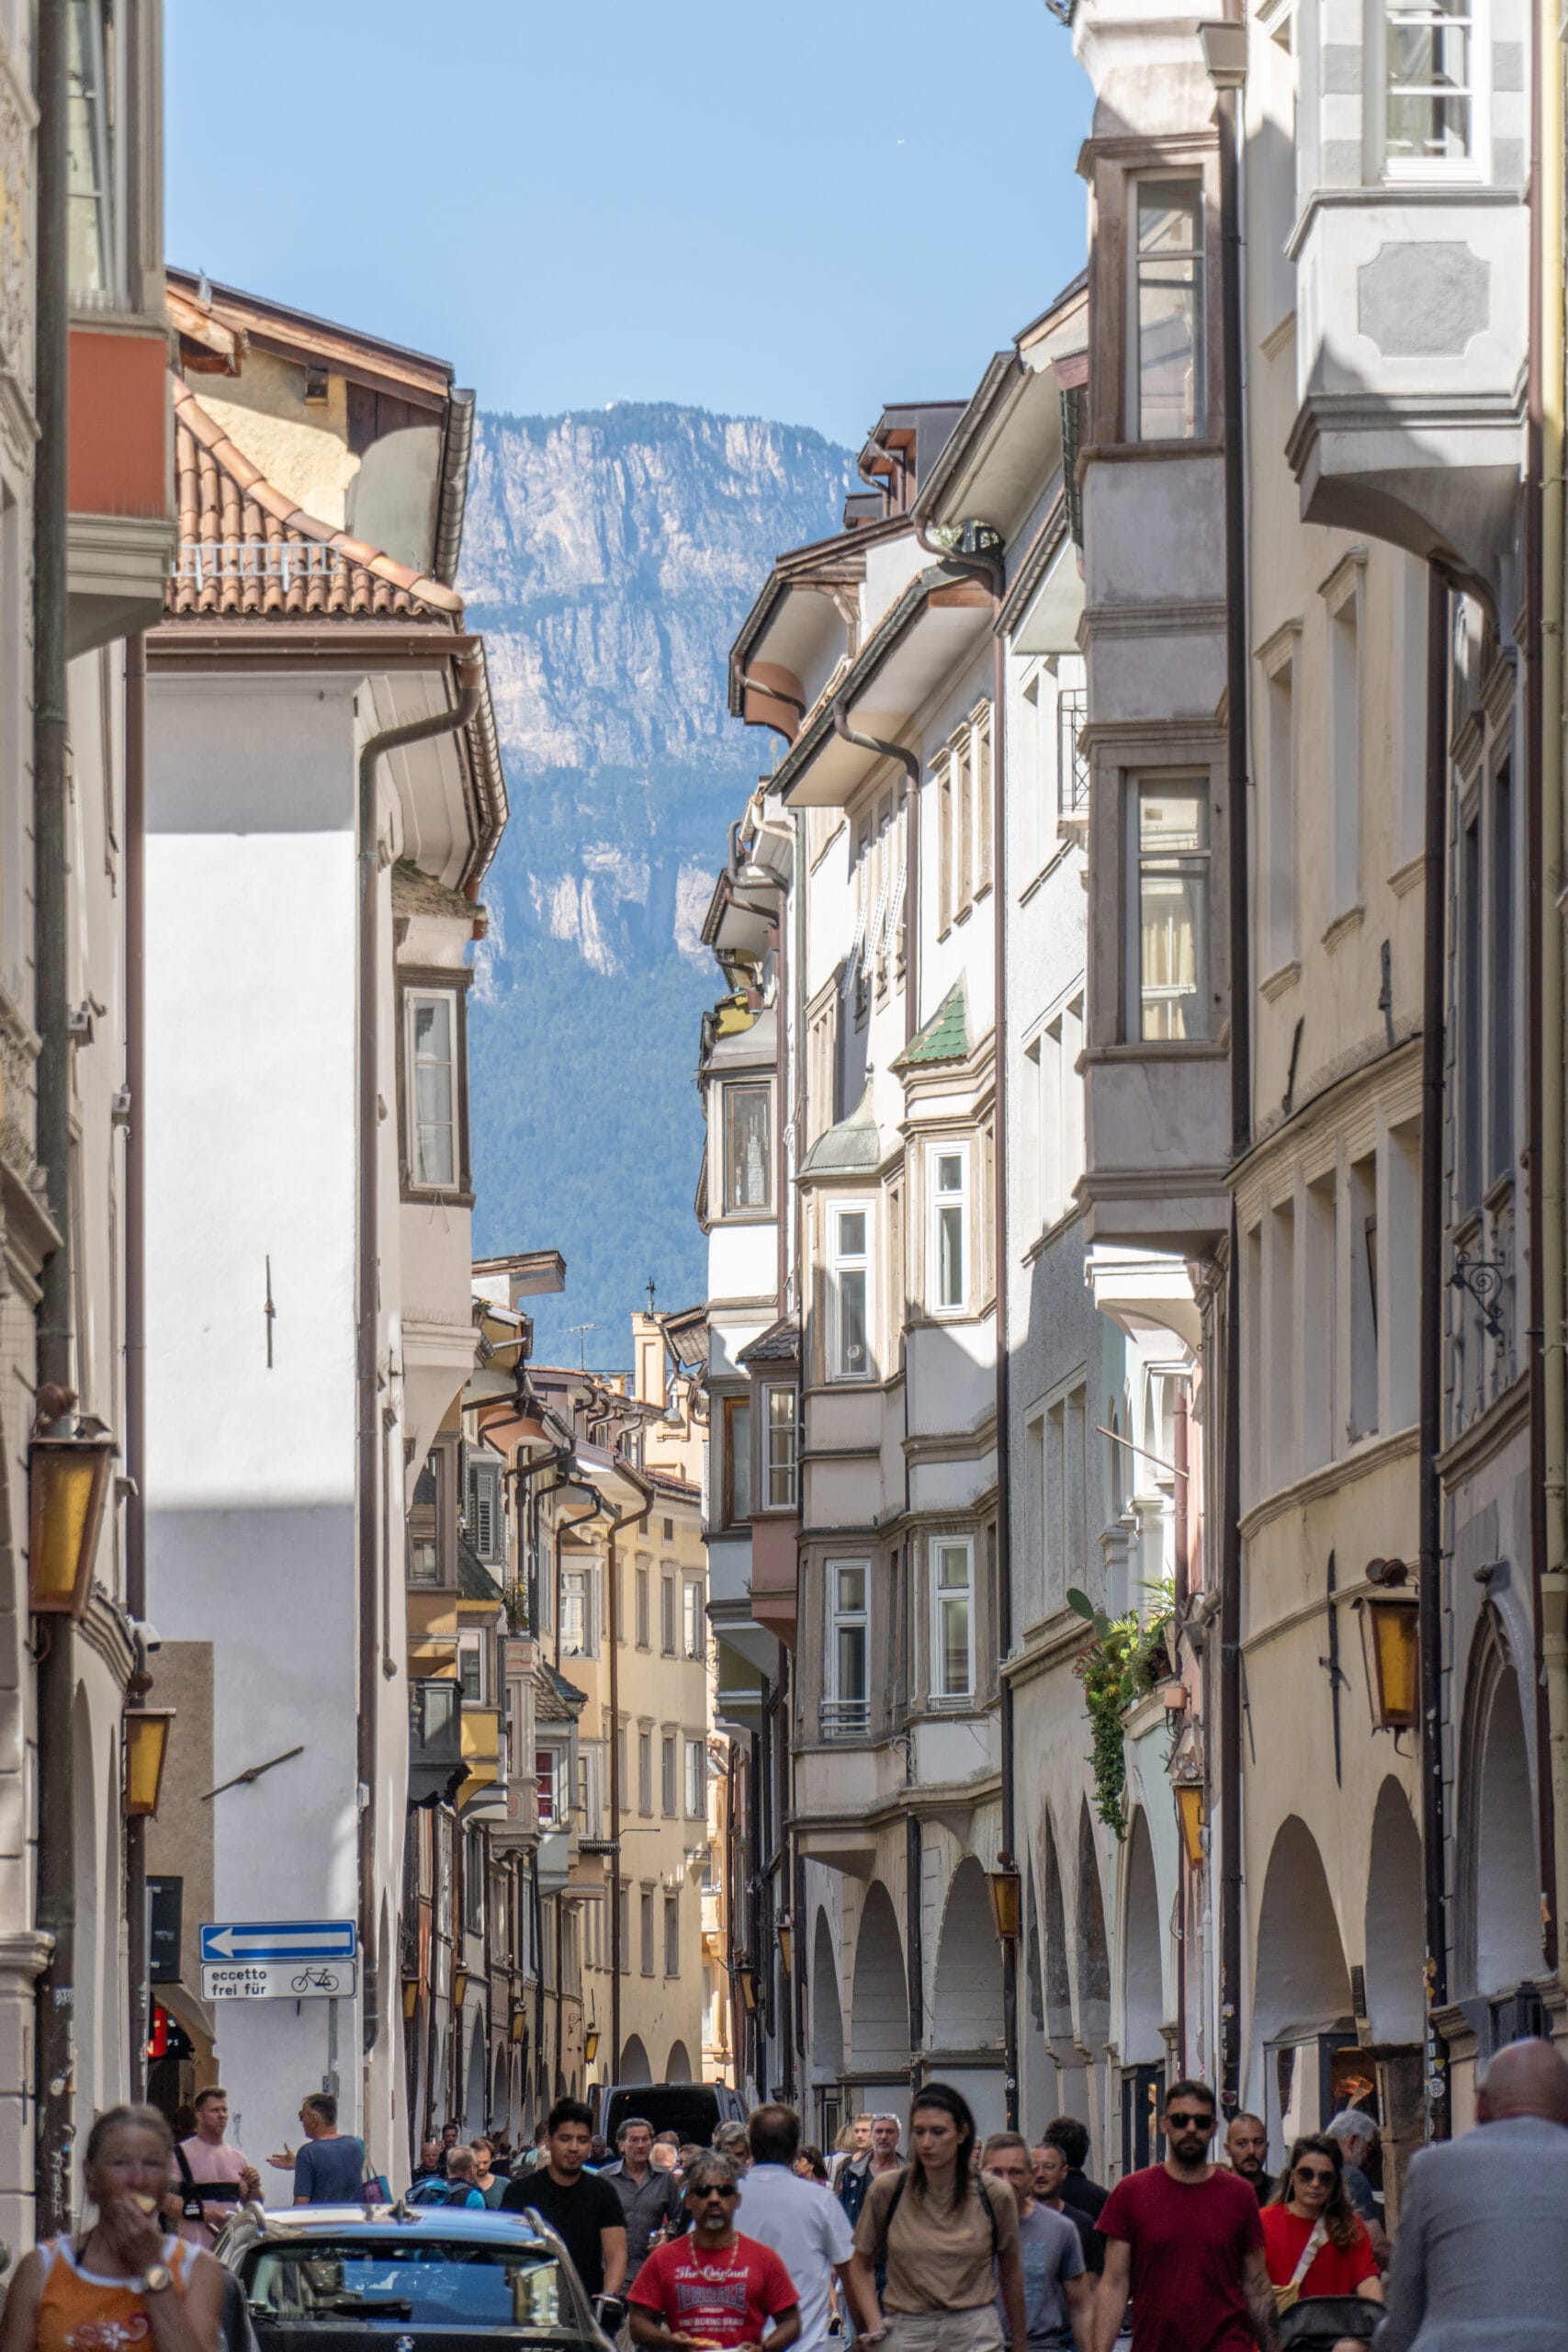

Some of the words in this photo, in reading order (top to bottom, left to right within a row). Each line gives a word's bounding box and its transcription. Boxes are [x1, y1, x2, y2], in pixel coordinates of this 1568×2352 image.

[211, 1968, 267, 1981] eccetto
[212, 1984, 237, 1996] frei
[244, 1982, 266, 1996] für
[675, 2266, 698, 2279] The
